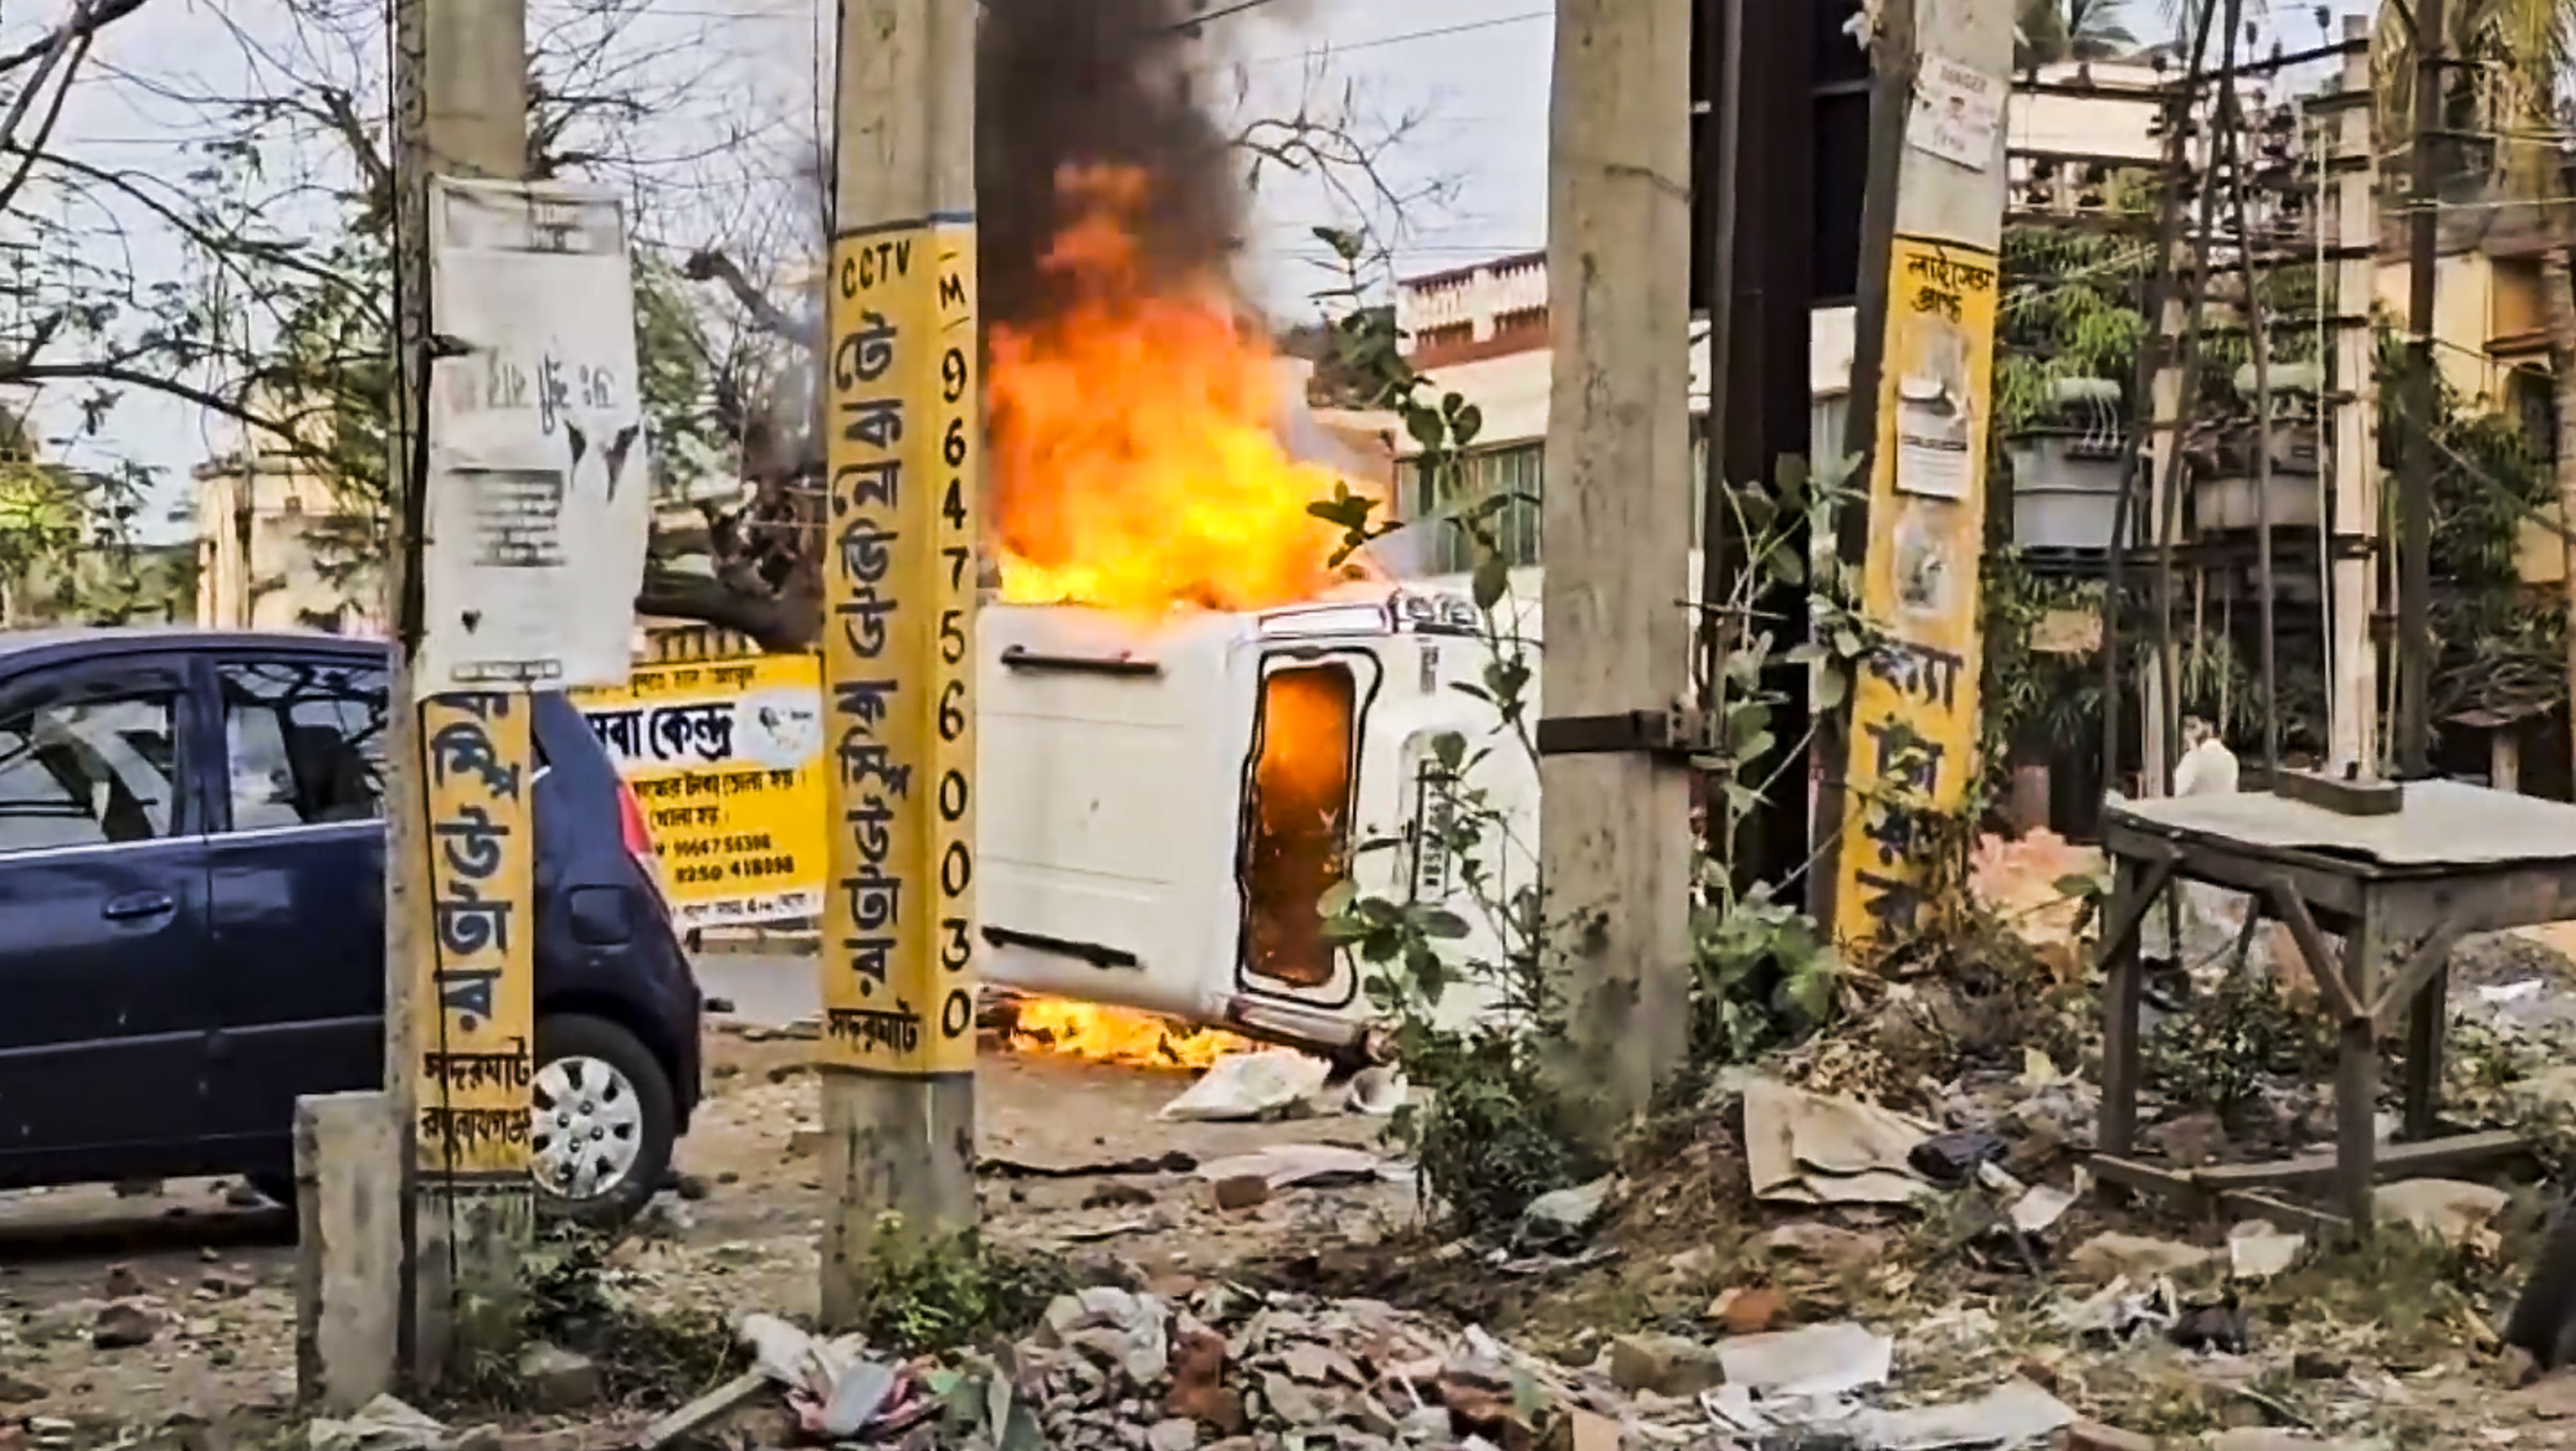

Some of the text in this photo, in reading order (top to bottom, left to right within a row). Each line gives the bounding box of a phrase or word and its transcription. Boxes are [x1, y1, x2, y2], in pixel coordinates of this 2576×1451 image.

[841, 239, 911, 299] CCTV
[939, 347, 971, 1038] 9647560030
[648, 701, 735, 762] কেন্দ্র
